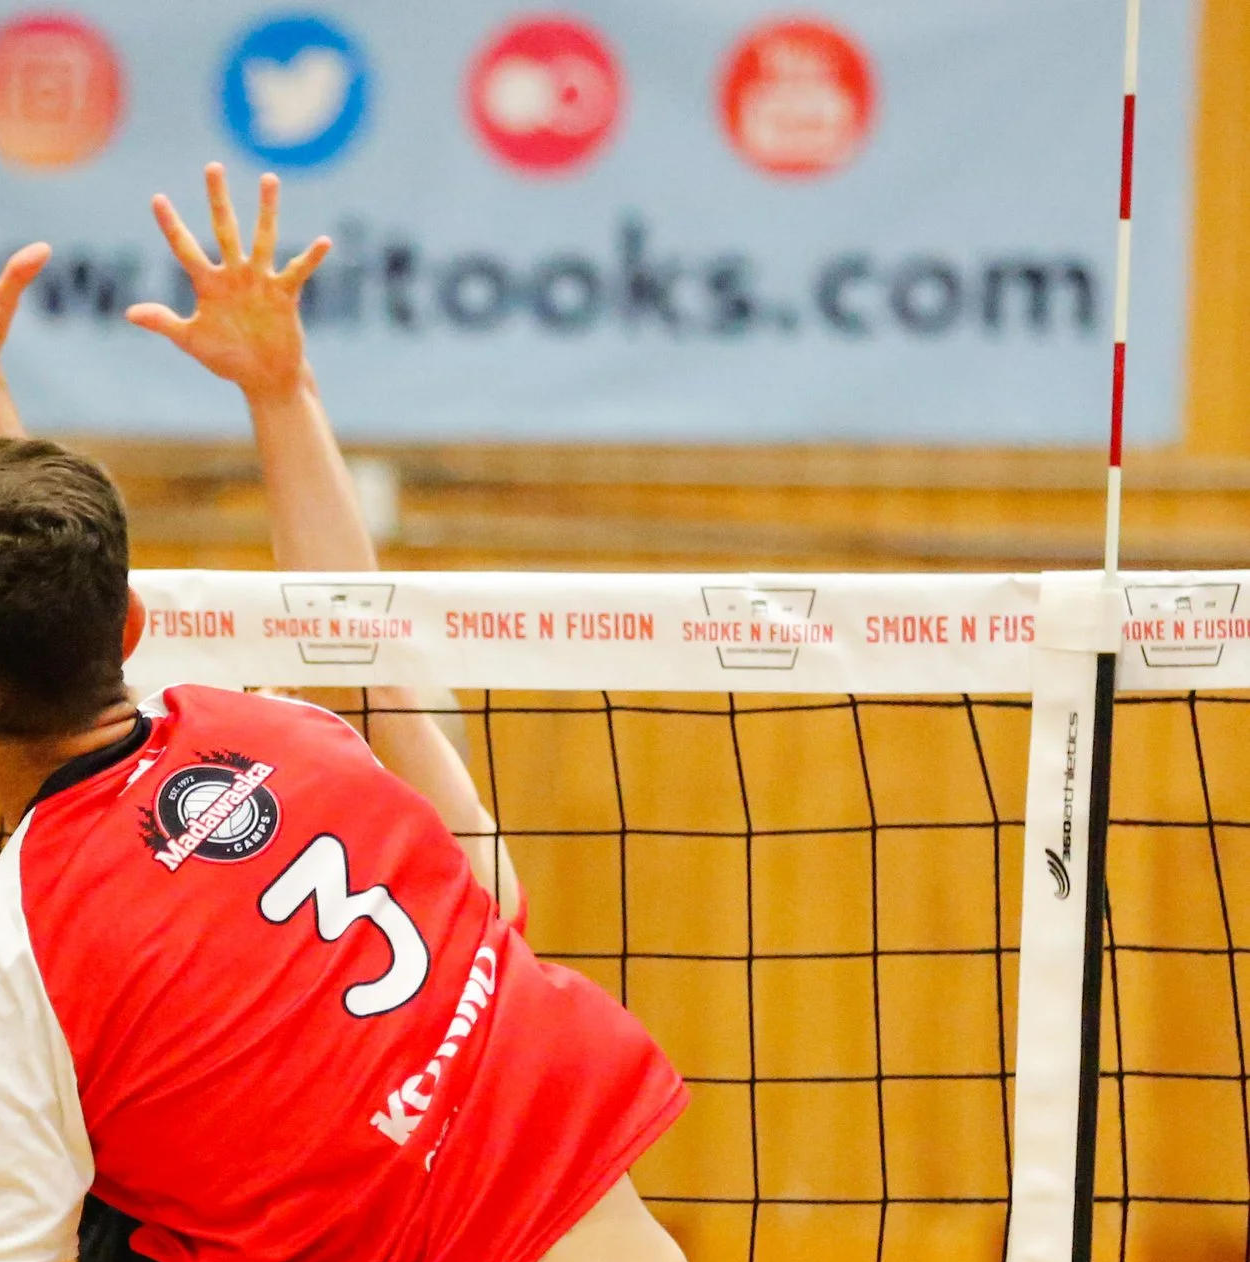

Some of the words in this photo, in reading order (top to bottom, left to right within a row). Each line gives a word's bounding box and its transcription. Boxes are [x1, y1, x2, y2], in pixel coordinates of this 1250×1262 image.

[149, 609, 236, 638] FUSION
[263, 618, 322, 638] SMOKE
[329, 619, 342, 637] N
[349, 619, 413, 639] FUSION
[445, 611, 526, 639] SMOKE
[538, 613, 554, 639] N
[566, 612, 655, 641] FUSION
[682, 621, 743, 642] SMOKE
[750, 623, 762, 643] N
[770, 624, 834, 644] FUSION
[866, 615, 949, 644] SMOKE
[961, 615, 976, 643] N
[989, 614, 1036, 643] FUS
[1173, 621, 1185, 640] N
[1193, 618, 1250, 640] FUSIO
[154, 762, 274, 871] Madawaska
[233, 815, 271, 852] CAMPS
[258, 832, 431, 1019] 3
